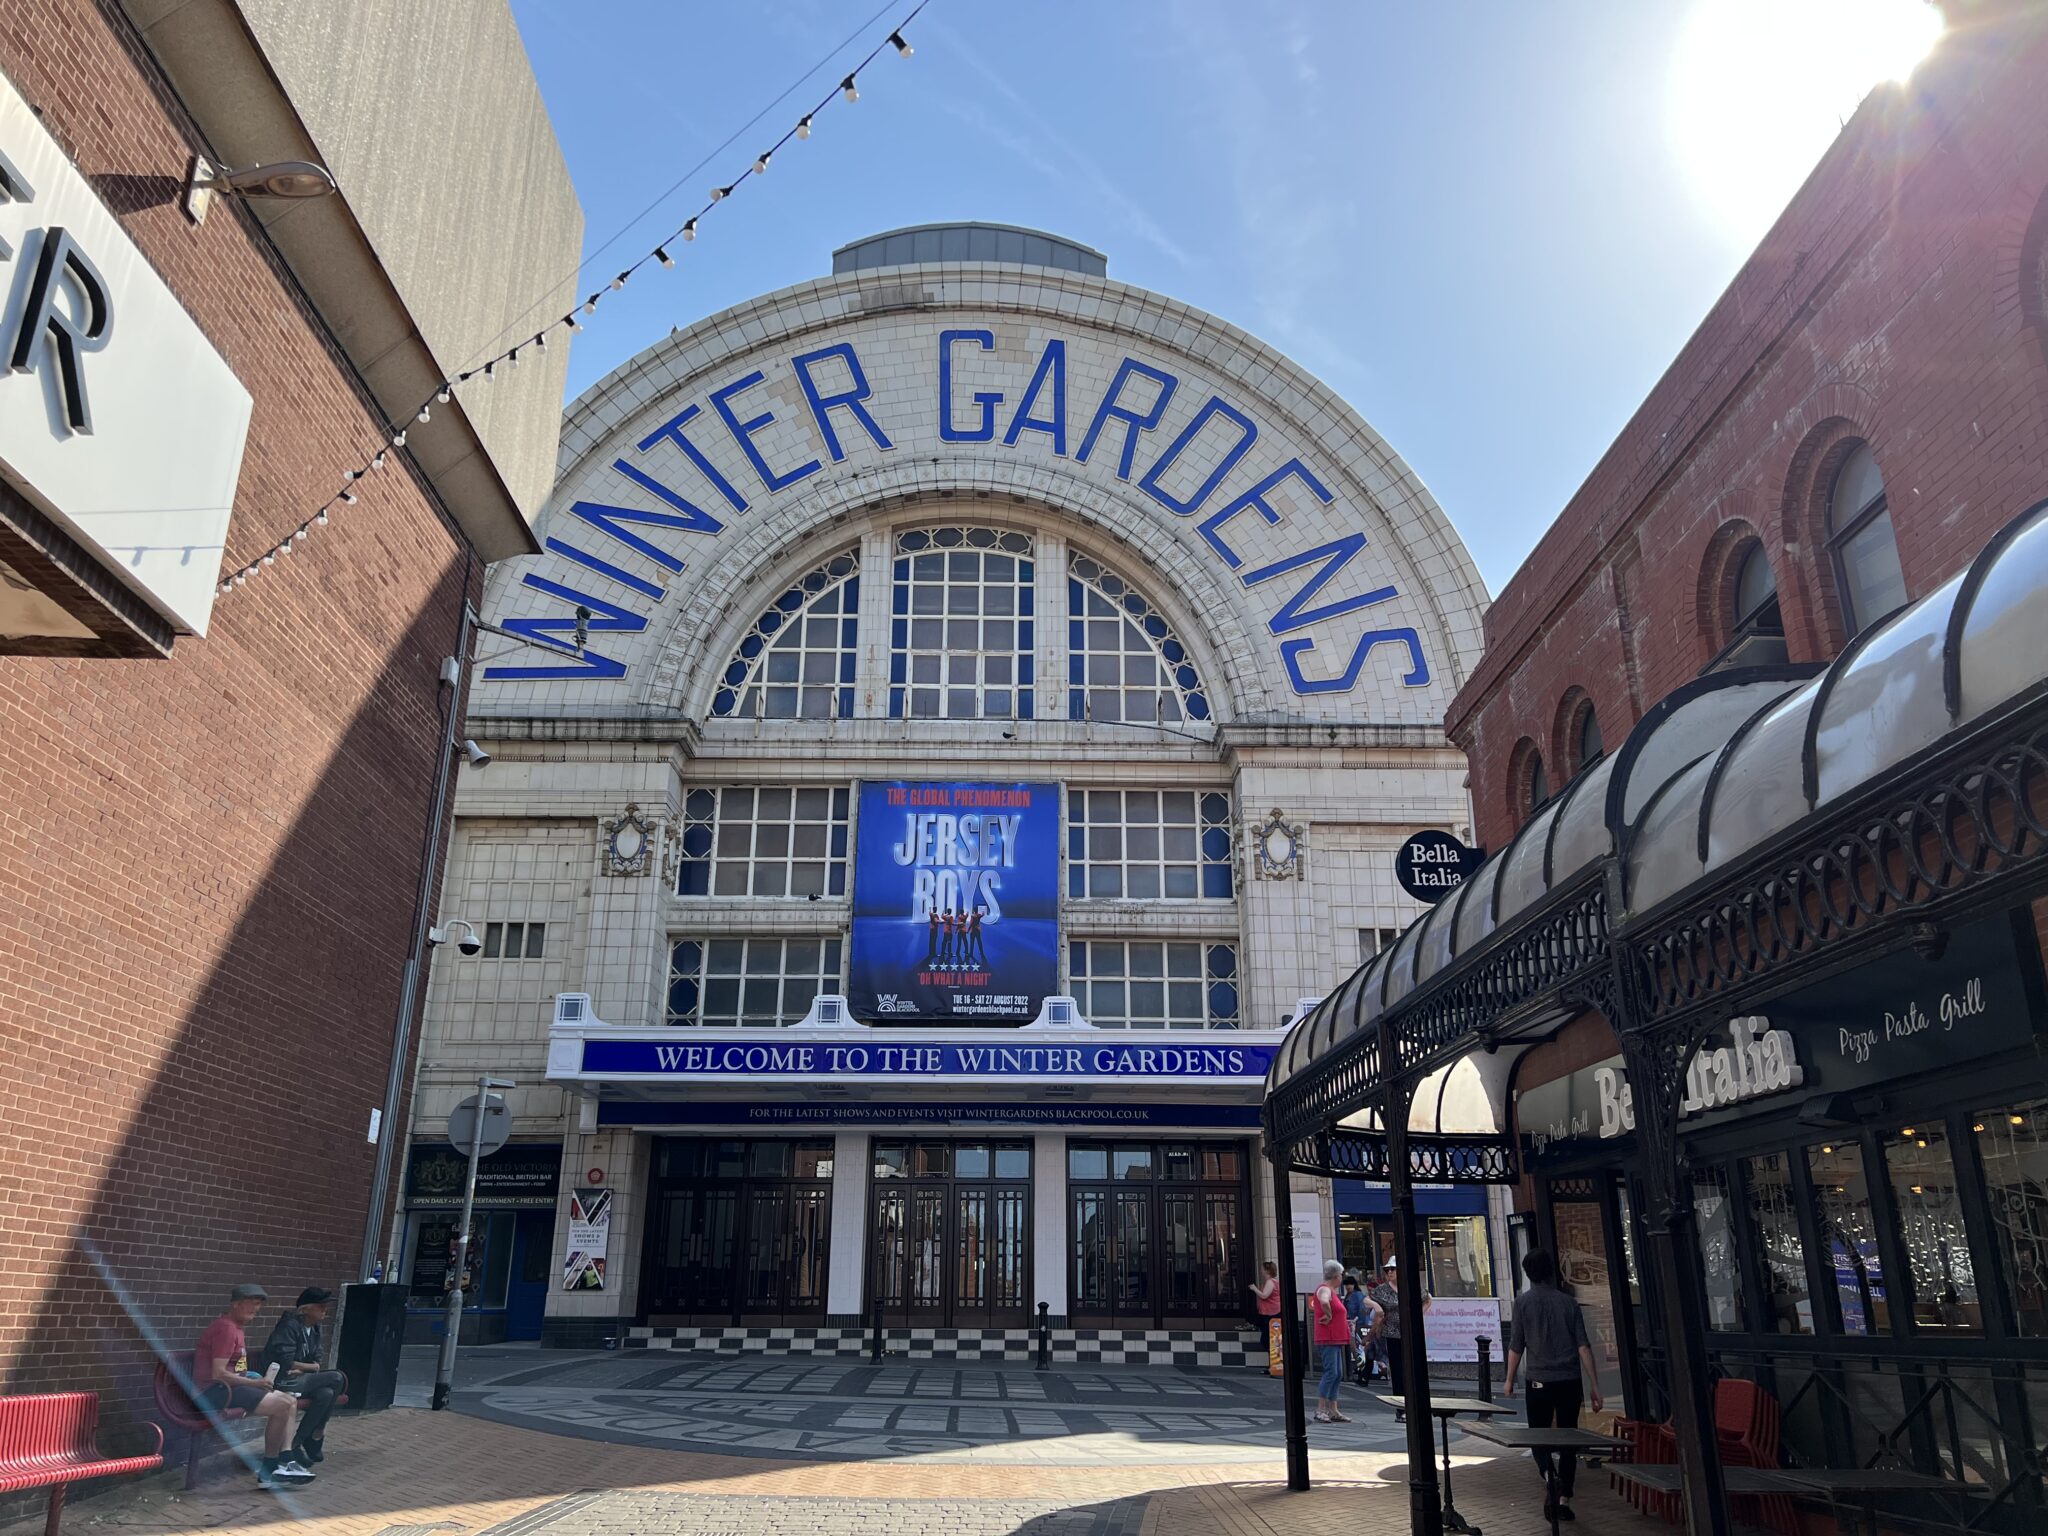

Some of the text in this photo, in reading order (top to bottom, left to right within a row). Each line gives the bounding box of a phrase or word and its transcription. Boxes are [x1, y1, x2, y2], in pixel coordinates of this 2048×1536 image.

[0, 148, 115, 437] R
[482, 328, 1432, 696] WINTER GARDENS
[887, 788, 1031, 808] THE GLOBAL PHENOMENON
[893, 812, 1022, 868] JERSEY
[1409, 843, 1461, 863] Bella
[1411, 867, 1462, 887] Italia
[911, 868, 1001, 925] BOYS
[933, 972, 955, 985] WHAT
[957, 973, 963, 985] A
[952, 994, 963, 1005] TUE
[964, 994, 971, 1005] 16
[975, 994, 985, 1005] SAT
[986, 995, 992, 1005] 27
[993, 995, 1012, 1006] AUGUST
[1013, 995, 1029, 1006] 2022
[1839, 977, 1986, 1063] Pizza Pasta Grill
[655, 1046, 1245, 1074] WELCOME TO THE WINTER GARDENS
[1683, 1015, 1800, 1112] Italia
[750, 1108, 770, 1118] FOR
[773, 1108, 794, 1118] THE
[796, 1108, 831, 1118] LATEST
[833, 1108, 870, 1118] SHOWS
[872, 1108, 896, 1118] AND
[897, 1108, 935, 1118] EVENTS
[937, 1109, 964, 1118] VISIT
[475, 1173, 552, 1181] TRADITIONAL BRITISH BAR
